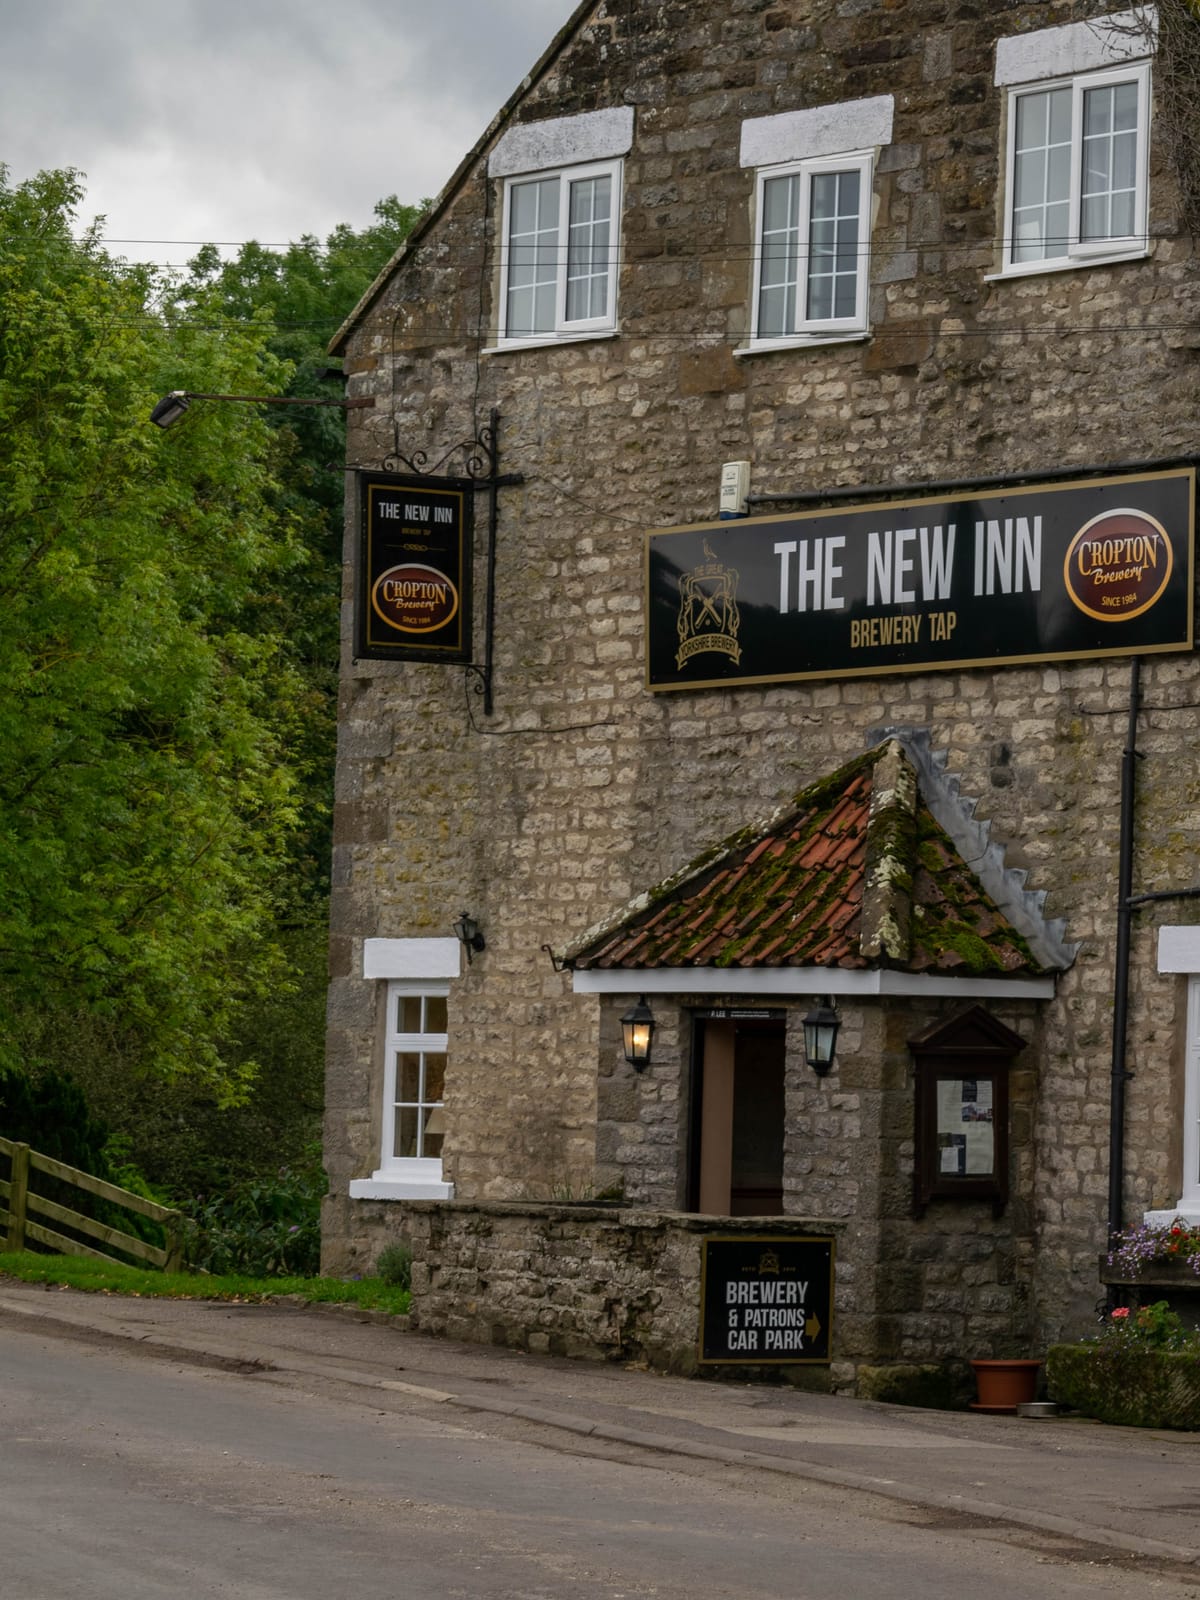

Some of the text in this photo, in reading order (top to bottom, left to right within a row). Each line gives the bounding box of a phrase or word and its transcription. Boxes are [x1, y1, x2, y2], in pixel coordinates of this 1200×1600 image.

[378, 502, 453, 524] THE NEW INN
[773, 515, 1042, 614] THE NEW INN
[1077, 534, 1159, 576] CROPTON
[1089, 566, 1144, 586] Brewery
[383, 580, 447, 605] CROPTON
[1101, 592, 1137, 607] SINCE 1984
[396, 598, 436, 612] Brewery
[850, 611, 957, 648] BREWERY TAP
[726, 1281, 809, 1304] BREWERY
[728, 1308, 805, 1327] & PATRONS
[728, 1330, 804, 1350] CAR PARK
